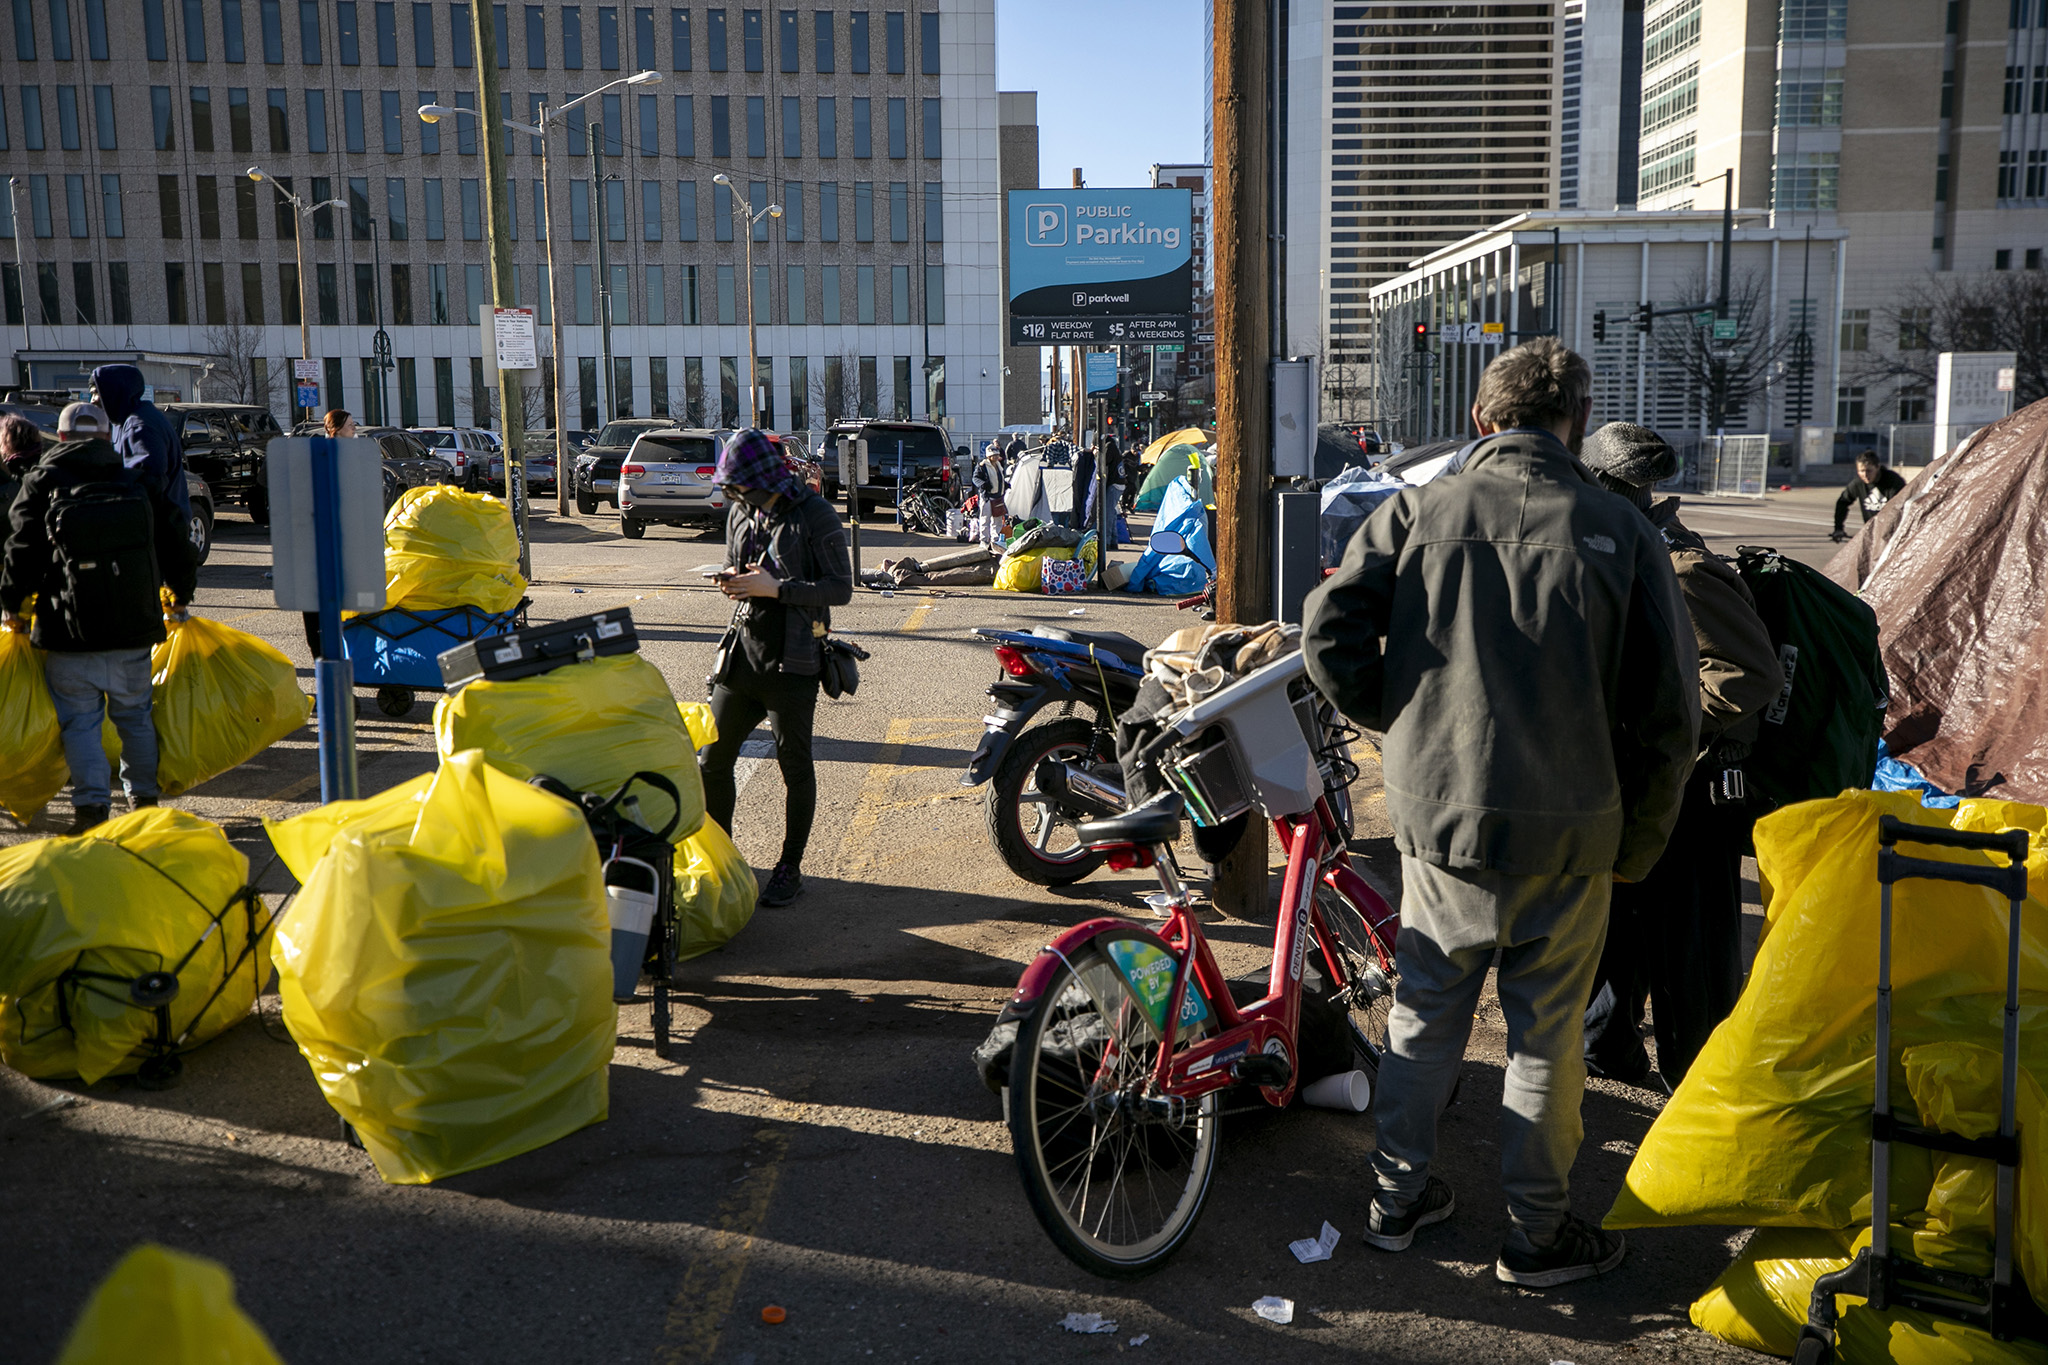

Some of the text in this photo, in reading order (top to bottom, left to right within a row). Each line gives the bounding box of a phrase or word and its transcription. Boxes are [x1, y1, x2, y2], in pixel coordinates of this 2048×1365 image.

[1076, 205, 1132, 218] PUBLIC
[1076, 221, 1181, 249] Parking
[1088, 293, 1130, 304] parkwell
[1022, 323, 1045, 338] $12
[1050, 321, 1093, 330] WEEKDAY
[1109, 322, 1125, 337] $5
[1129, 320, 1177, 329] AFTER 4PM
[1050, 331, 1095, 339] FLAT RATE
[1129, 330, 1185, 339] & WEEKENDS
[1292, 926, 1305, 975] DENVER
[1129, 957, 1172, 983] POWERED
[1148, 975, 1160, 990] BY
